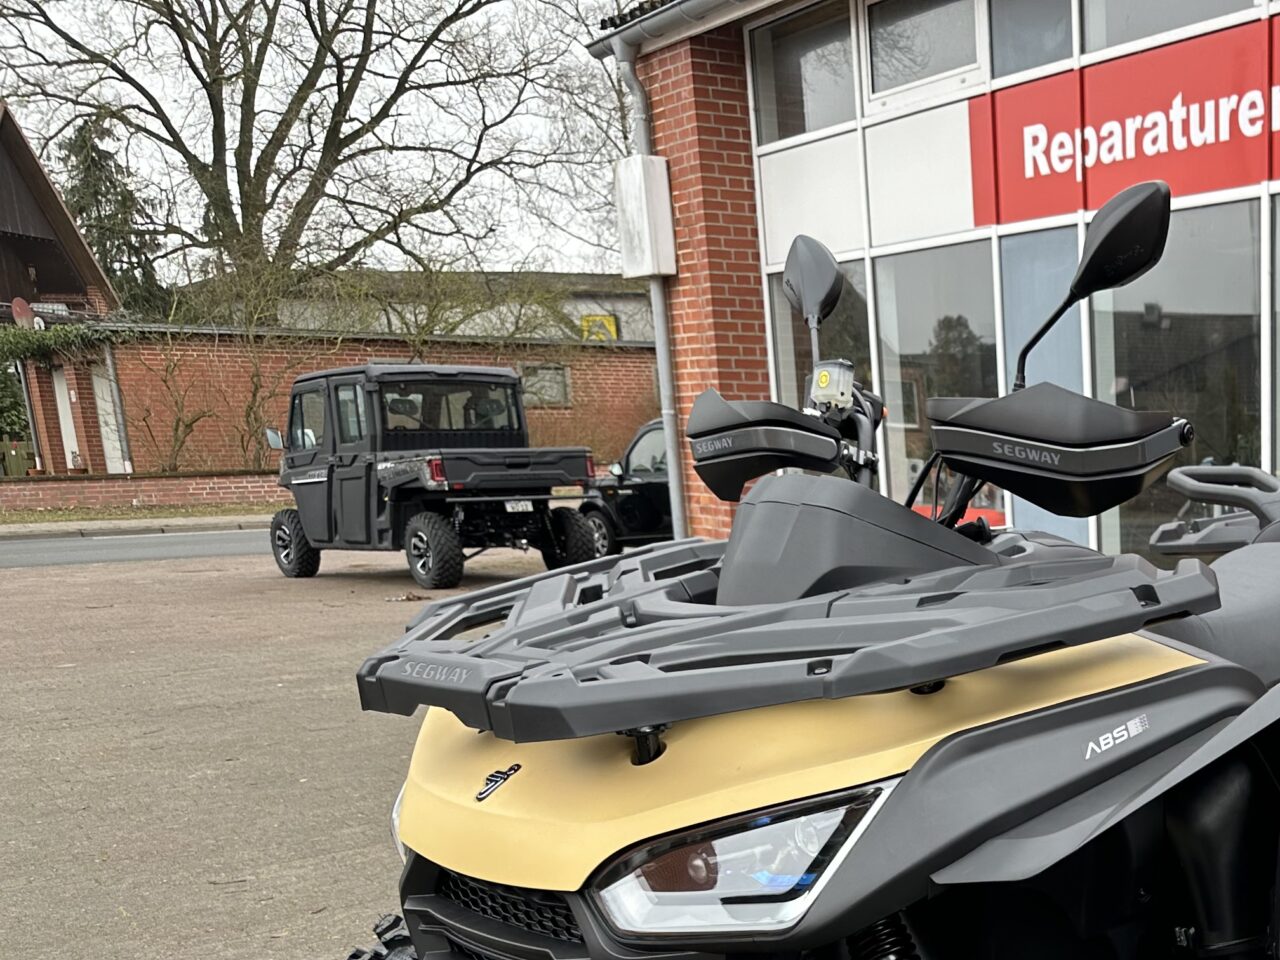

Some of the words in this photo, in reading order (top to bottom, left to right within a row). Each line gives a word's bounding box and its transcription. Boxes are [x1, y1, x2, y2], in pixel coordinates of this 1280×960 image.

[696, 437, 734, 454] SEGWAY
[992, 441, 1061, 465] SEGWAY
[401, 661, 473, 684] SEGWAY
[1084, 724, 1129, 761] ABS
